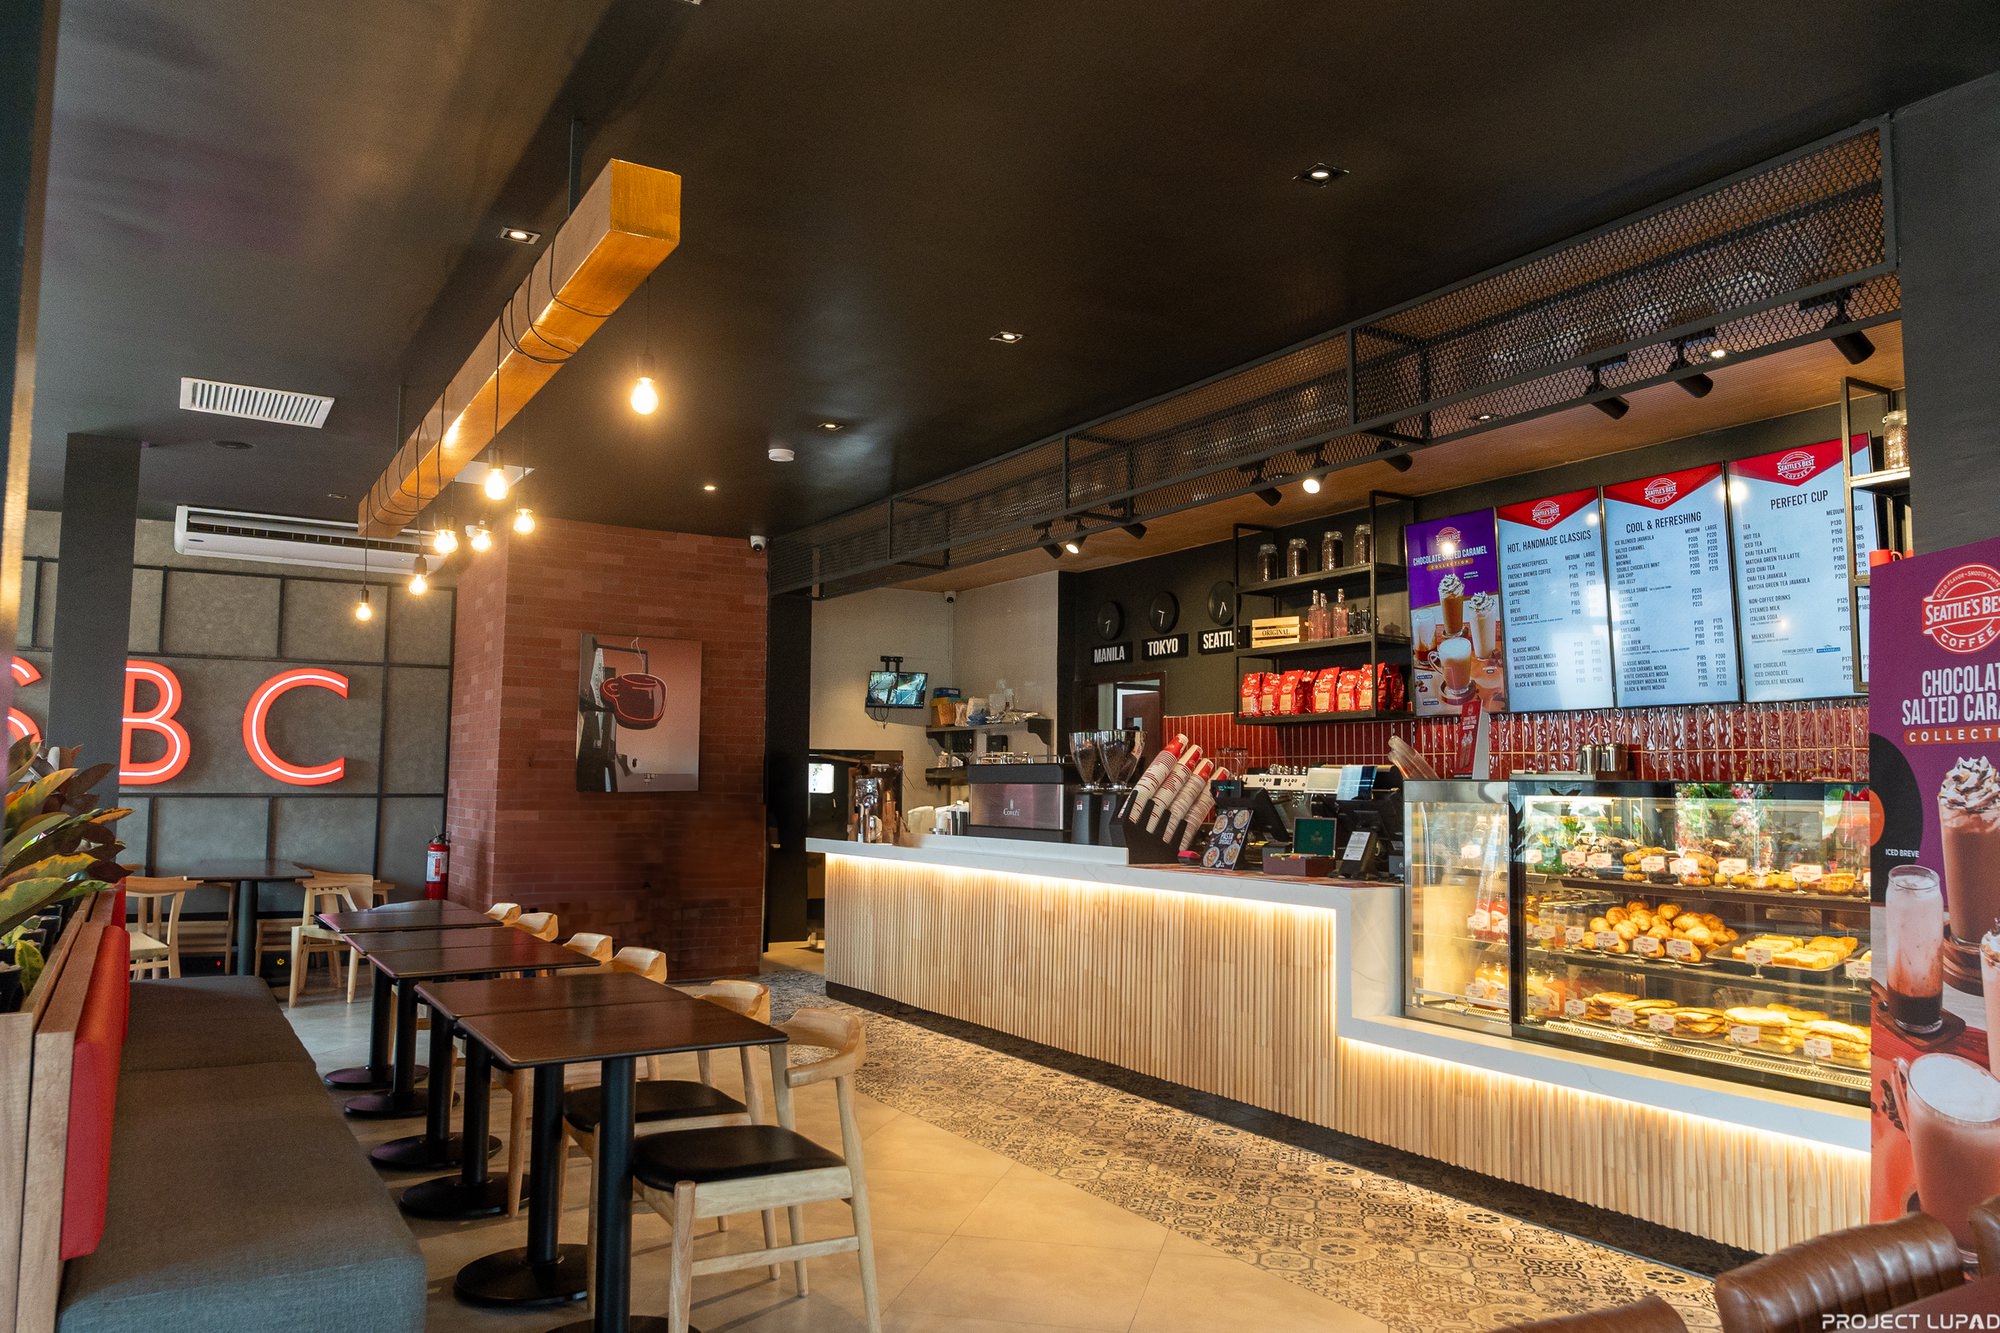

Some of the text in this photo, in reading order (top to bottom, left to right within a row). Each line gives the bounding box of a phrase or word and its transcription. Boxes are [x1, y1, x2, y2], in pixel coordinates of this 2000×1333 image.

[1770, 490, 1828, 510] PERFECT CUP
[1626, 511, 1701, 533] COOL & REFRESHING
[1507, 530, 1592, 554] HOT, HANDMADE CLASSICS
[1413, 553, 1441, 566] CHOCOLATE
[1462, 546, 1488, 557] CARAMEL
[1431, 560, 1469, 570] COLLECTION
[1507, 562, 1521, 570] CLASSIC
[1523, 570, 1537, 578] BREWED
[1538, 568, 1551, 576] COFFEE
[1937, 585, 1949, 599] BOLD
[1925, 596, 2000, 625] SEATTLE'S BE
[1203, 630, 1237, 650] SEATTL
[1261, 628, 1291, 636] ORIGINAL
[1941, 626, 1995, 648] COFFEE
[1094, 645, 1125, 663] MANILA
[1147, 638, 1179, 656] TOKYO
[1922, 662, 2000, 697] CHOCOLAT
[1902, 692, 2000, 726] SALTED CAR
[1885, 848, 1920, 858] ICED BREVE
